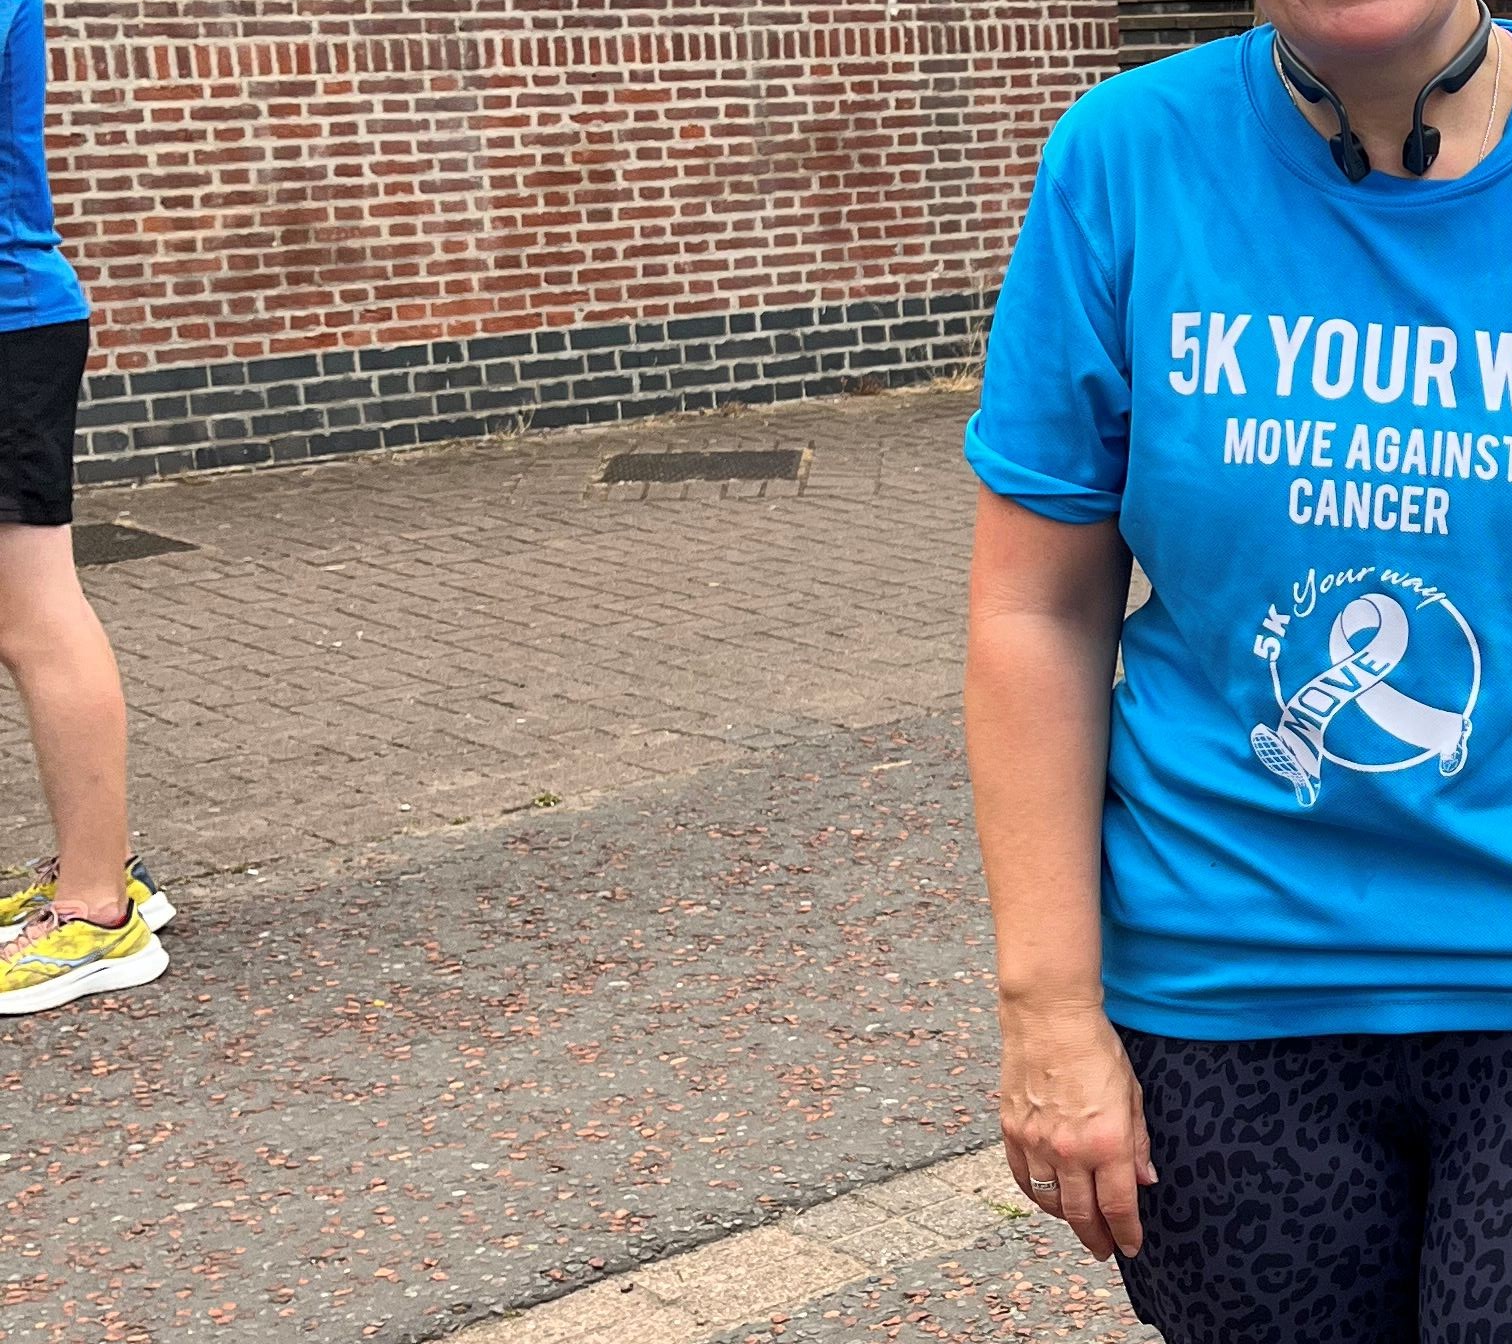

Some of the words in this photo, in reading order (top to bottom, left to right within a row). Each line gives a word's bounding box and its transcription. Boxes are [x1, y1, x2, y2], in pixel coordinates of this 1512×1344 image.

[1168, 311, 1252, 397] 5K
[1268, 314, 1458, 409] YOUR
[1223, 417, 1337, 468] MOVE
[1288, 477, 1451, 536] CANCER
[1253, 603, 1291, 662] 5K
[1292, 566, 1376, 618] Your
[1380, 568, 1447, 611] way
[1283, 651, 1391, 757] MOVE
